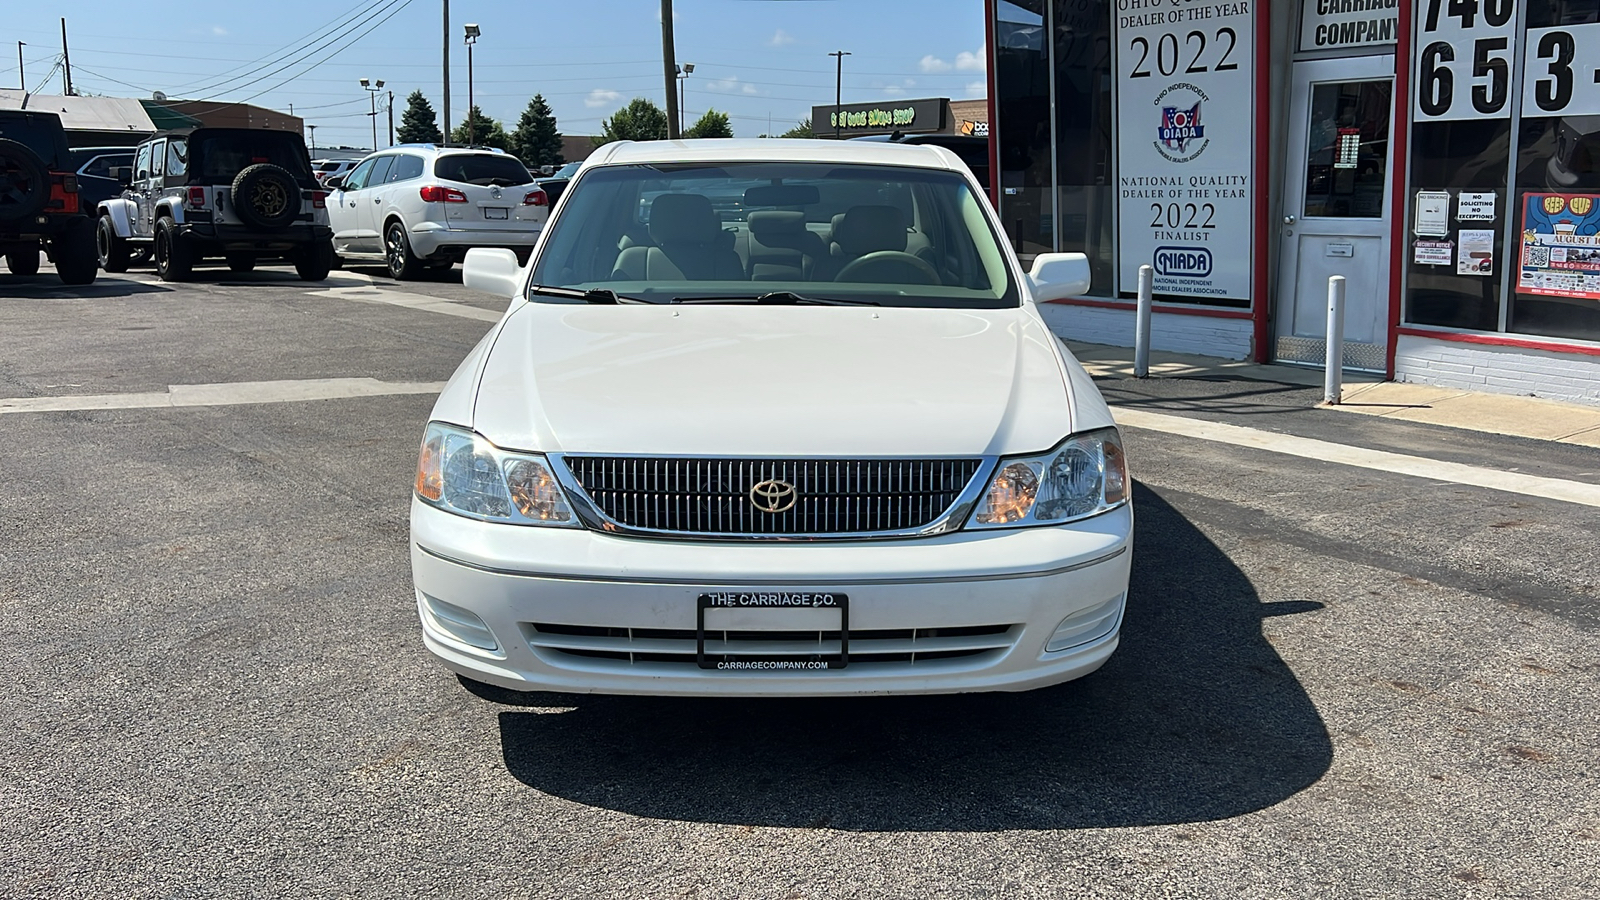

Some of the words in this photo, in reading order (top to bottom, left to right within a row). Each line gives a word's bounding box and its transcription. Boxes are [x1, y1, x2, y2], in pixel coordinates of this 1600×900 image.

[1118, 0, 1160, 11] OHIO
[1317, 0, 1399, 15] CARRIA
[1120, 12, 1165, 28] DEALER
[1168, 10, 1184, 23] OF
[1187, 6, 1212, 20] THE
[1215, 2, 1249, 17] YEAR
[1315, 18, 1398, 46] COMPANY
[1129, 27, 1238, 78] 2022
[1154, 89, 1168, 106] OHIO
[1167, 82, 1209, 102] INDEPENDENT
[830, 111, 847, 128] BST
[893, 107, 915, 125] SHOP
[1163, 127, 1197, 139] OIADA
[1153, 141, 1171, 161] AUTOMOBILE
[1189, 138, 1210, 161] ASSOCIATION
[1121, 176, 1184, 187] NATIONAL
[1189, 175, 1248, 188] QUALITY
[1122, 189, 1164, 198] DEALER
[1168, 189, 1183, 198] OF
[1187, 189, 1210, 198] THE
[1215, 189, 1246, 198] YEAR
[1150, 202, 1216, 229] 2022
[1154, 231, 1210, 241] FINALIST
[1553, 235, 1590, 244] AUGUST
[1158, 252, 1207, 271] NIADA
[708, 593, 736, 606] THE
[739, 593, 810, 606] CARRIAGE
[813, 593, 837, 606] CO.
[717, 661, 828, 669] CARRIAGECOMPANY.COM
